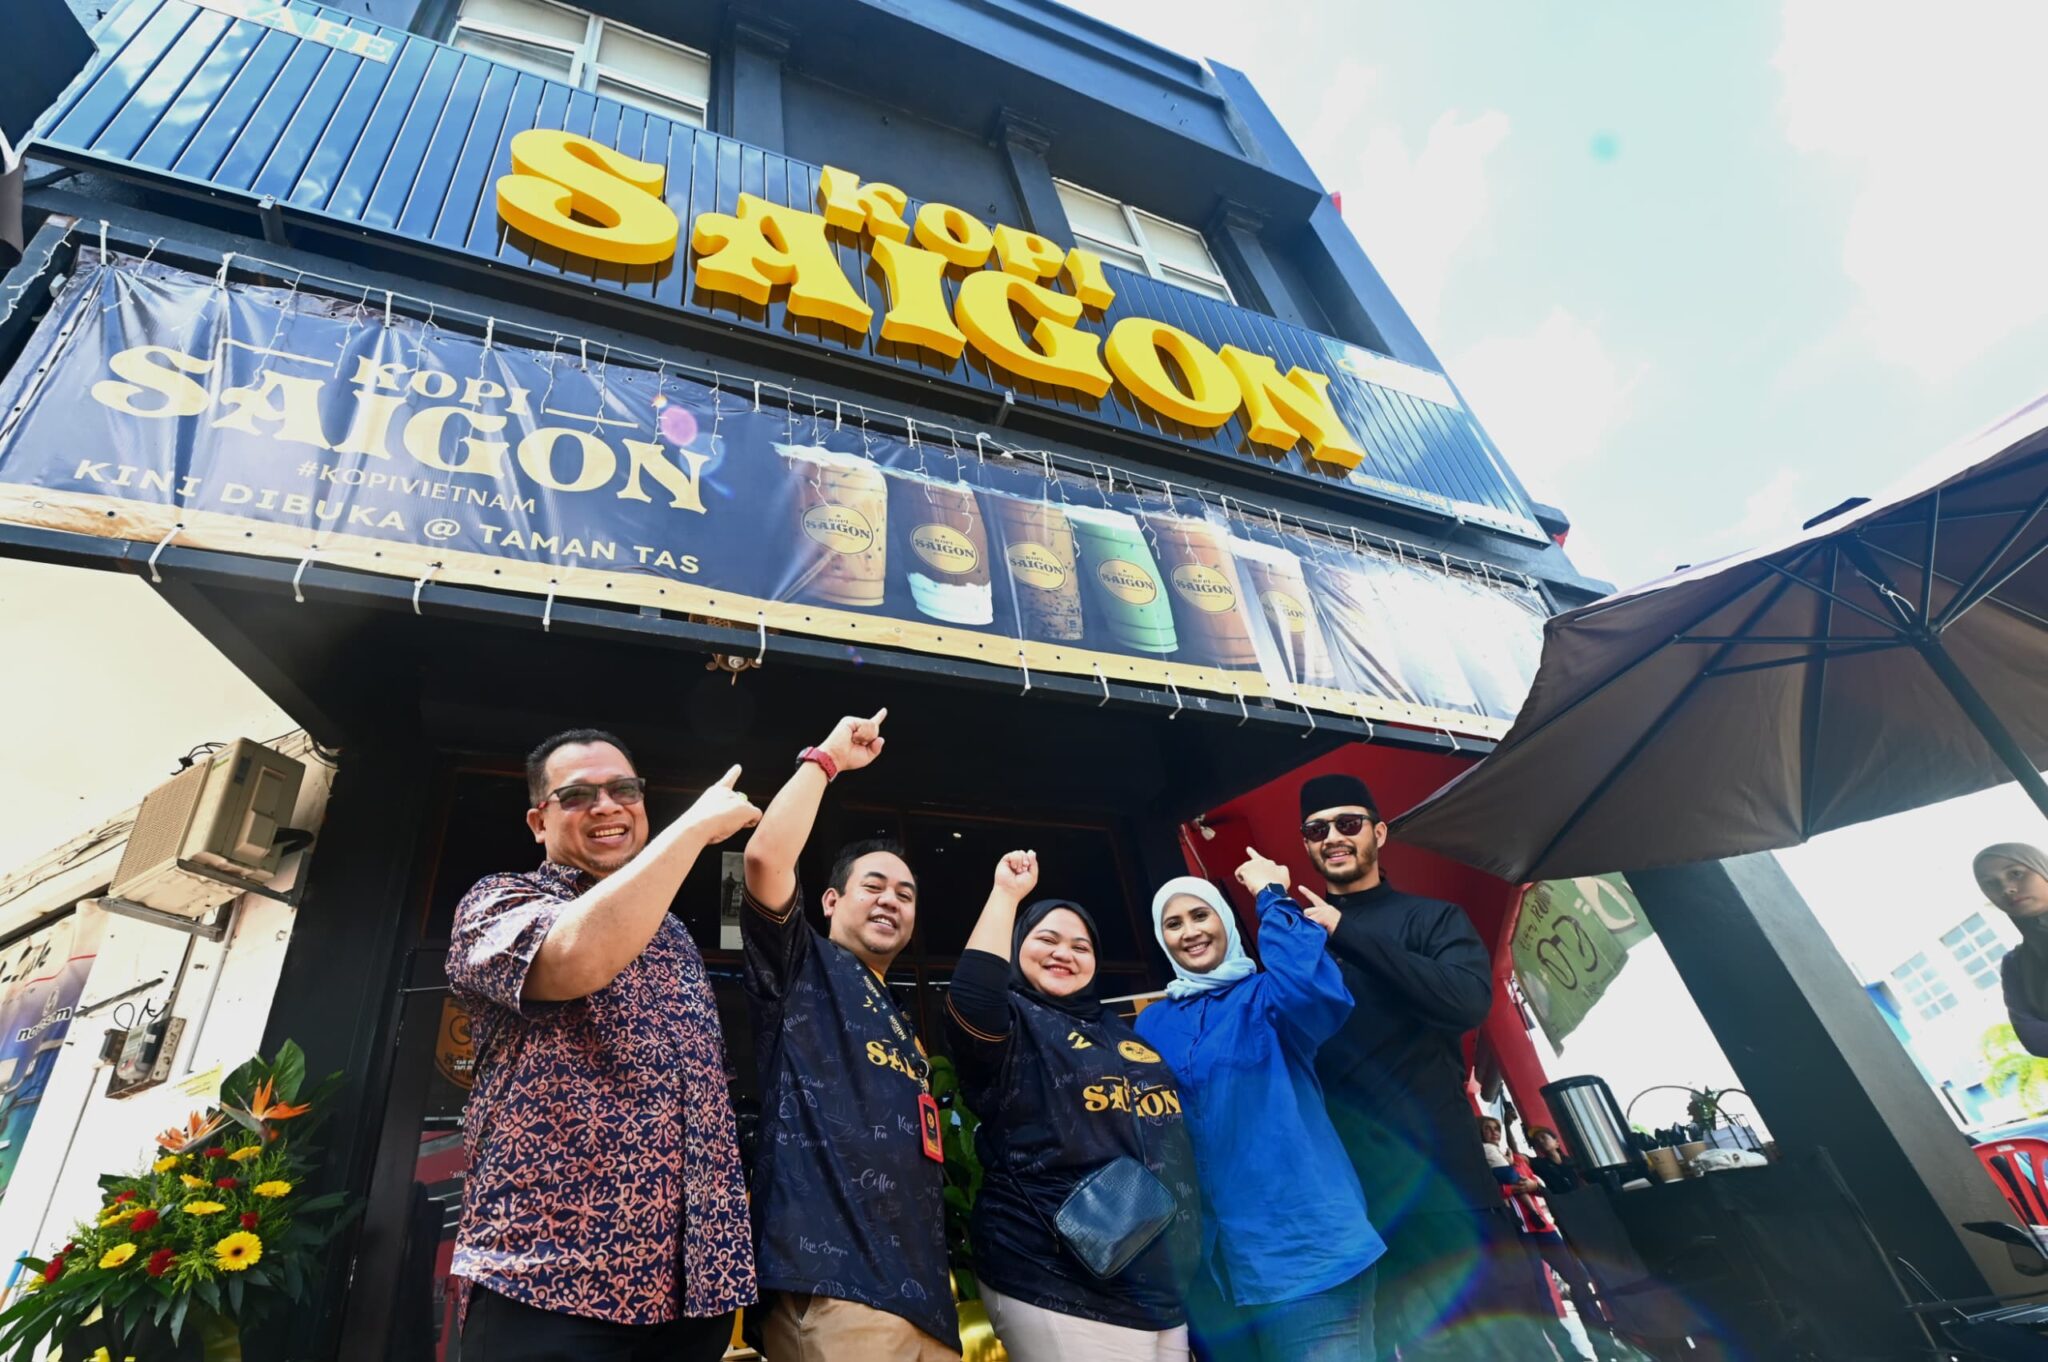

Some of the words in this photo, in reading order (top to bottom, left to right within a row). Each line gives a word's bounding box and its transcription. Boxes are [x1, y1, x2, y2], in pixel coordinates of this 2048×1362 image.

[817, 164, 1115, 311] KOPI
[496, 129, 1365, 470] SAIGON
[349, 355, 531, 416] KOPI
[91, 345, 711, 515] SAIGON
[297, 460, 536, 514] #KOPIVIETNAM
[73, 460, 203, 497] KINI
[220, 482, 406, 531] DIBUKA
[423, 518, 461, 541] @
[478, 523, 617, 561] TAMAN
[633, 545, 701, 574] TAS
[804, 519, 871, 540] SAIGON
[914, 538, 976, 559] SAIGON
[1010, 557, 1064, 575] SAIGON
[1101, 573, 1154, 592] SAIGON
[1175, 578, 1233, 596] SAIGON
